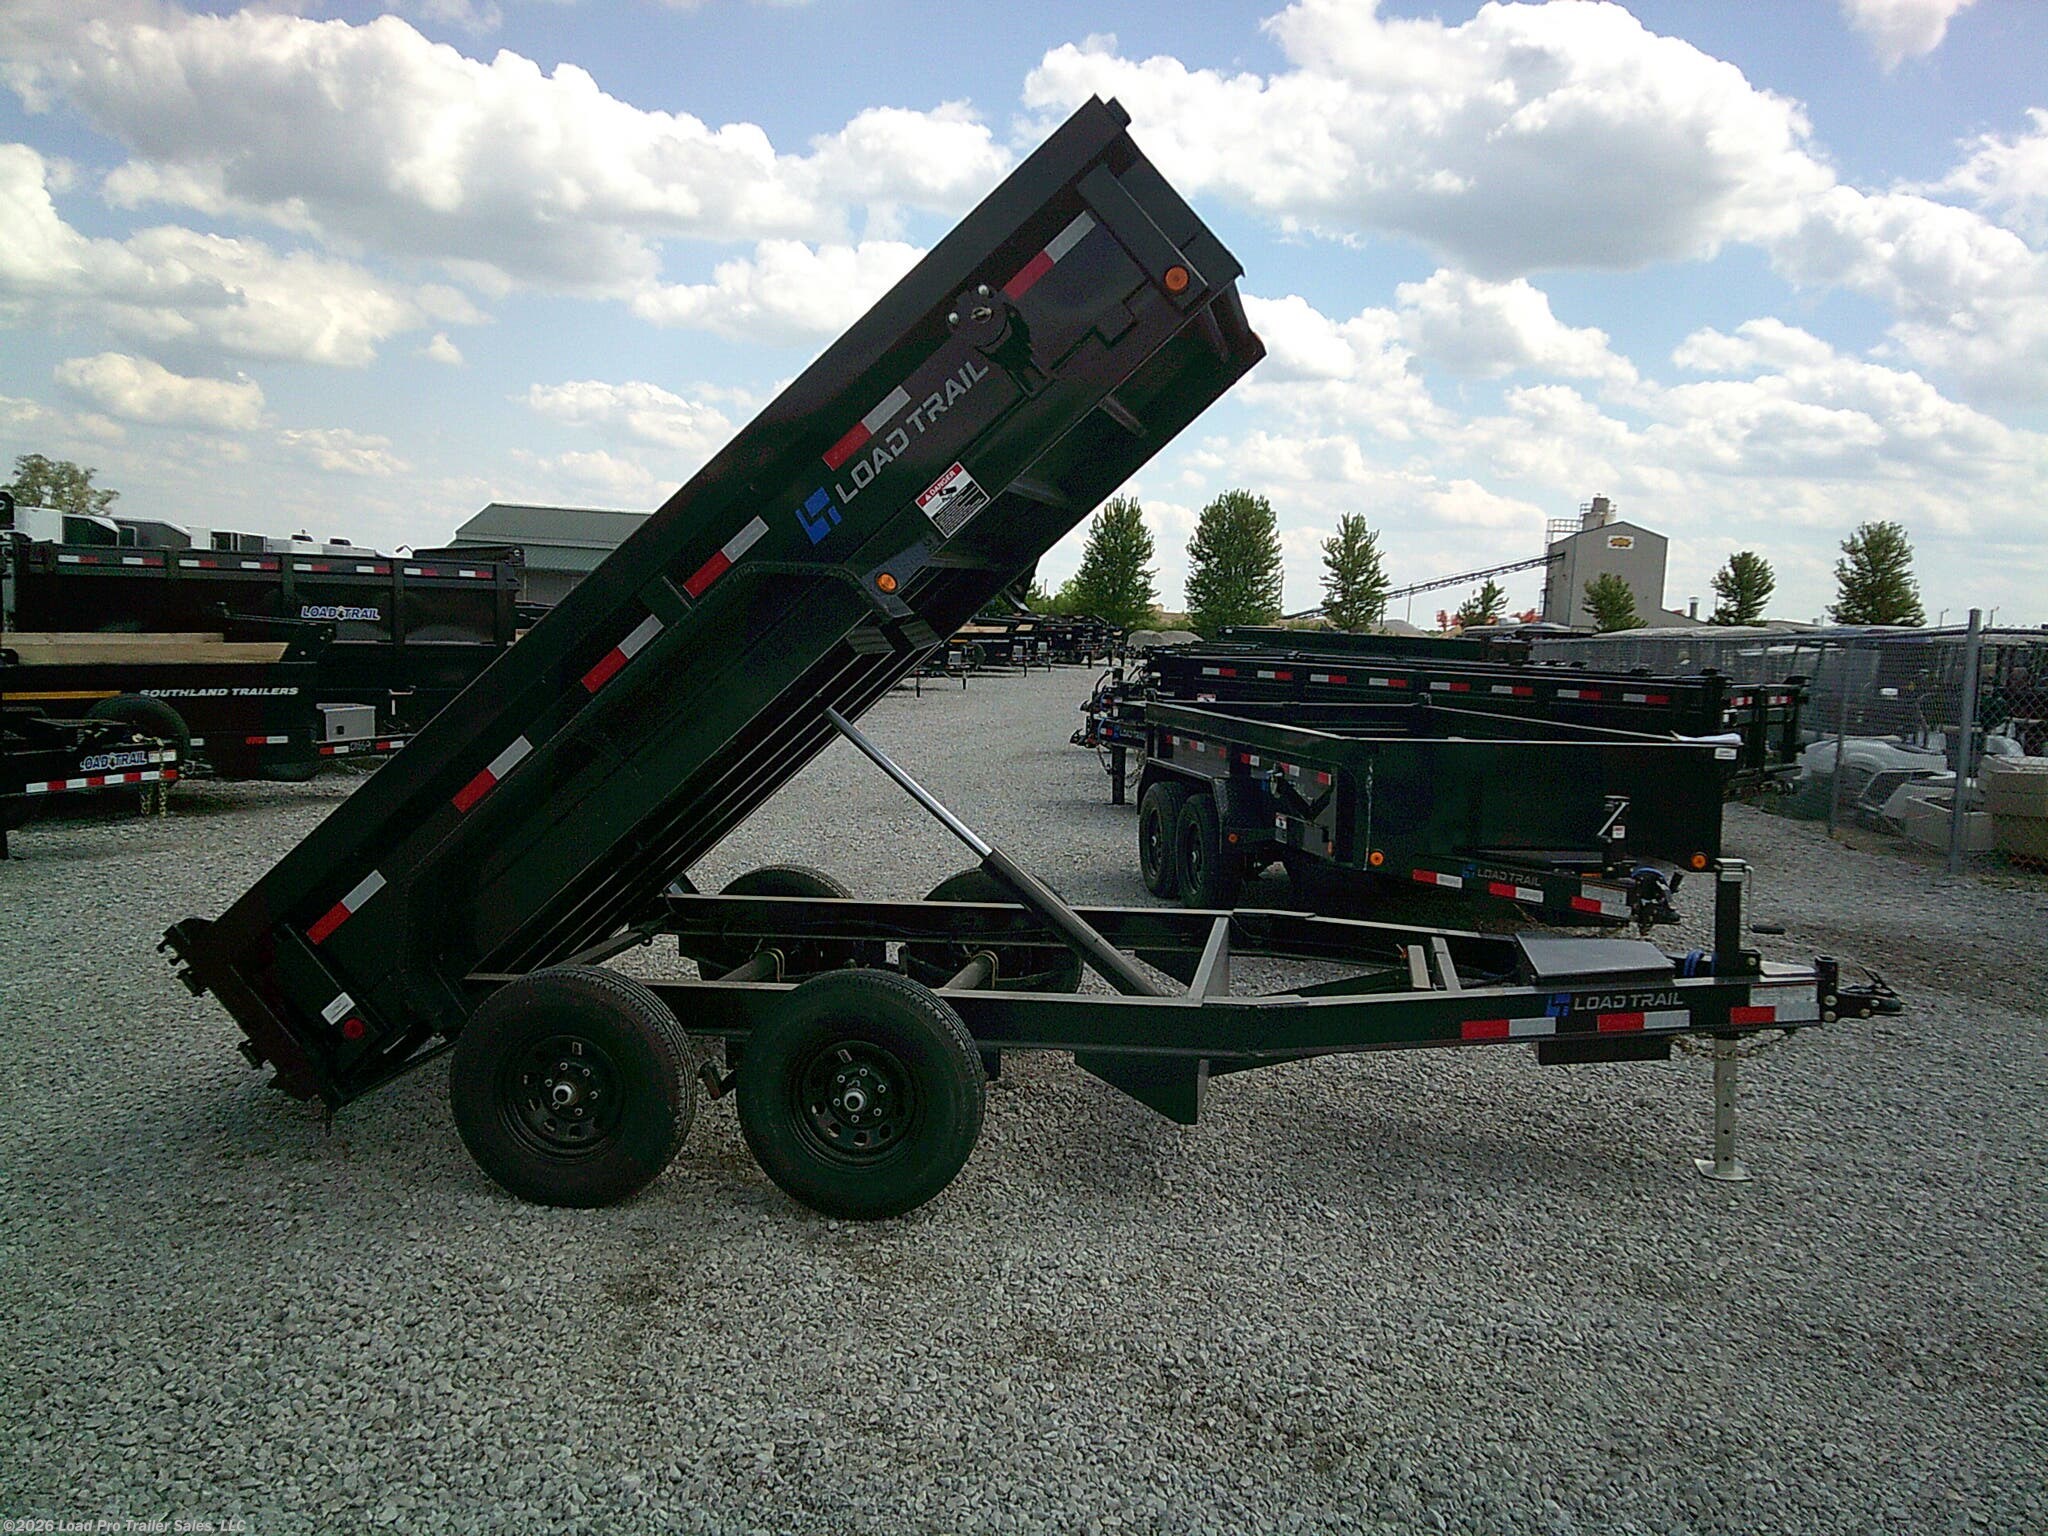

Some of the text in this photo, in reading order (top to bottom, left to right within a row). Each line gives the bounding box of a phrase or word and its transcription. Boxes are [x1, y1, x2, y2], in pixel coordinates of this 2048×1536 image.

[834, 361, 989, 504] LOAD TRAIL
[929, 470, 957, 497] DANGER
[301, 606, 381, 621] LOAD TRAIL
[139, 687, 299, 698] SOUTHLAND TRAILERS
[114, 751, 148, 768] TRAIL
[1477, 868, 1541, 886] LOAD TRAIL
[1573, 992, 1684, 1011] LOAD TRAIL
